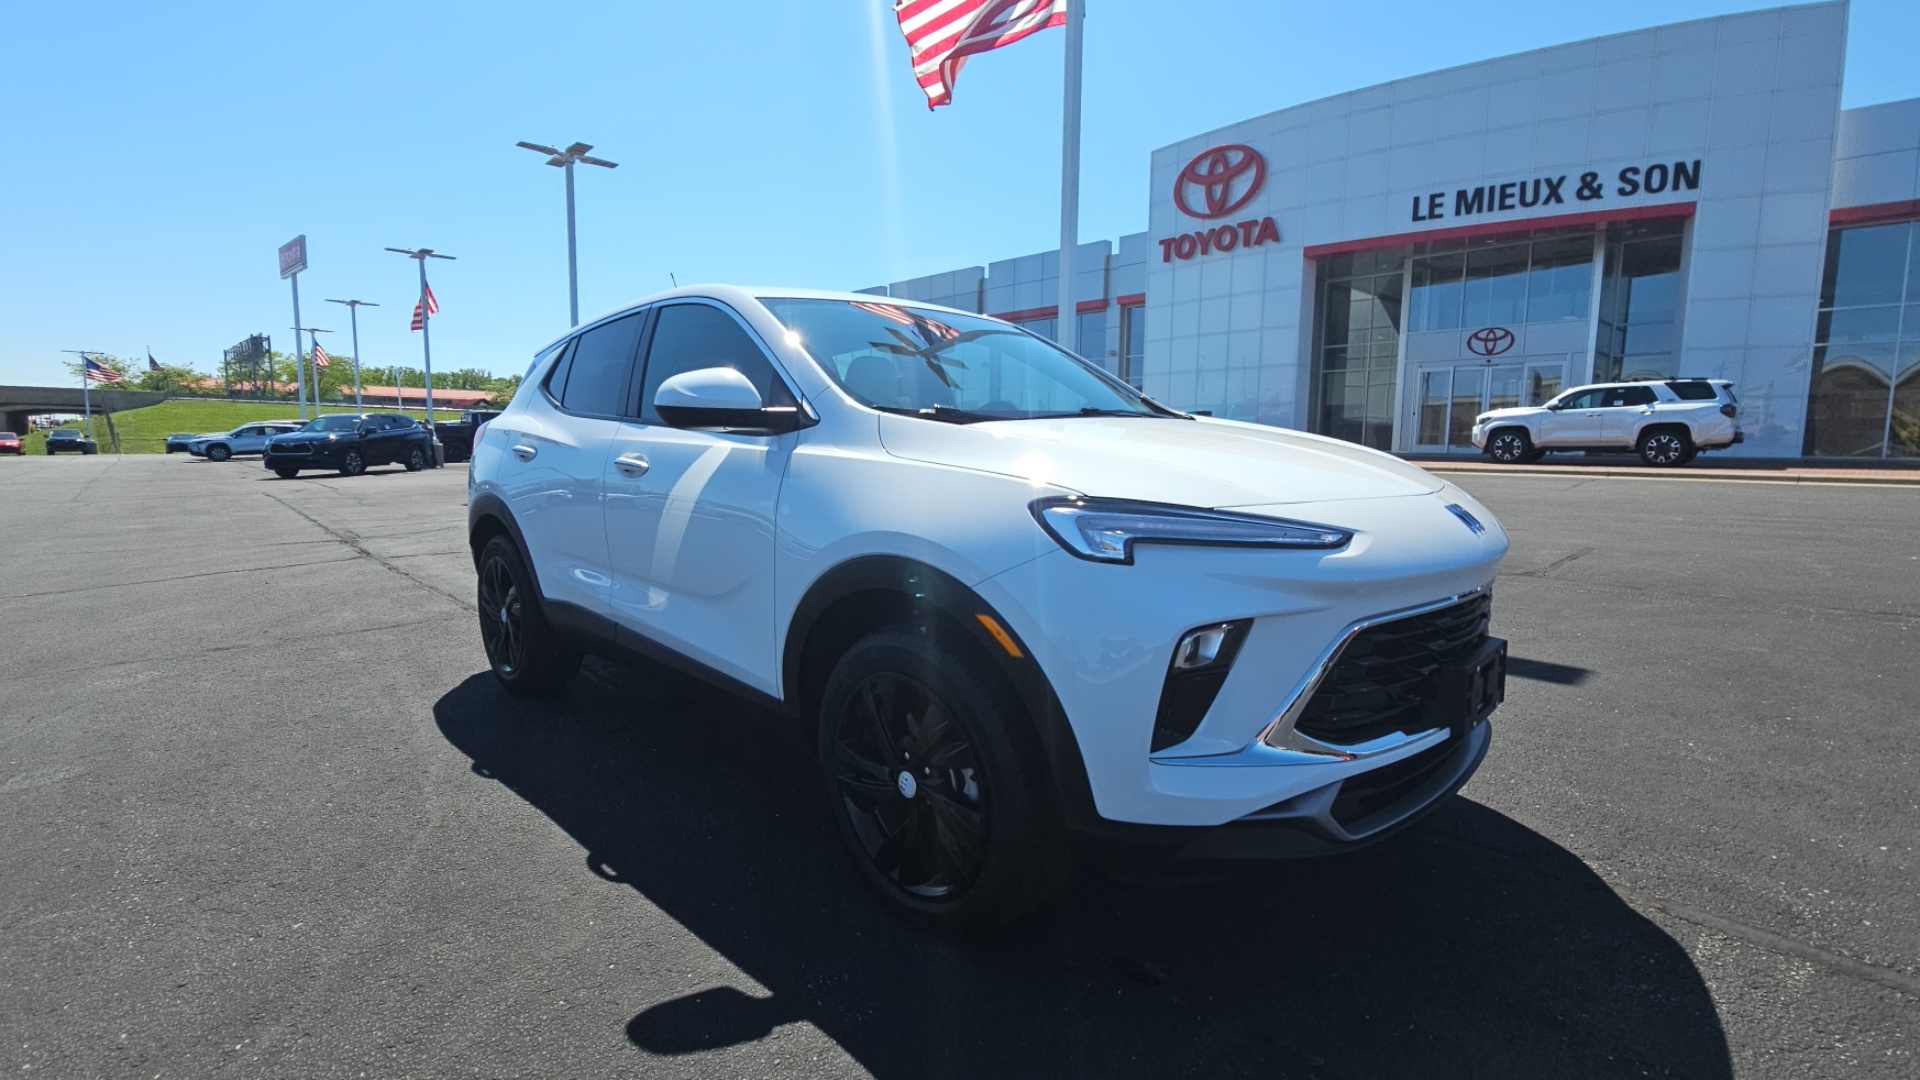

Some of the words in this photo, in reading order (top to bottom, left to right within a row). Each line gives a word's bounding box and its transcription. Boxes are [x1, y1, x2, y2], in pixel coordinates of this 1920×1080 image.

[1412, 193, 1445, 222] LE
[1455, 176, 1566, 216] MIEUX
[1576, 172, 1604, 201] &
[1617, 160, 1701, 197] SON
[1159, 217, 1280, 262] TOYOTA
